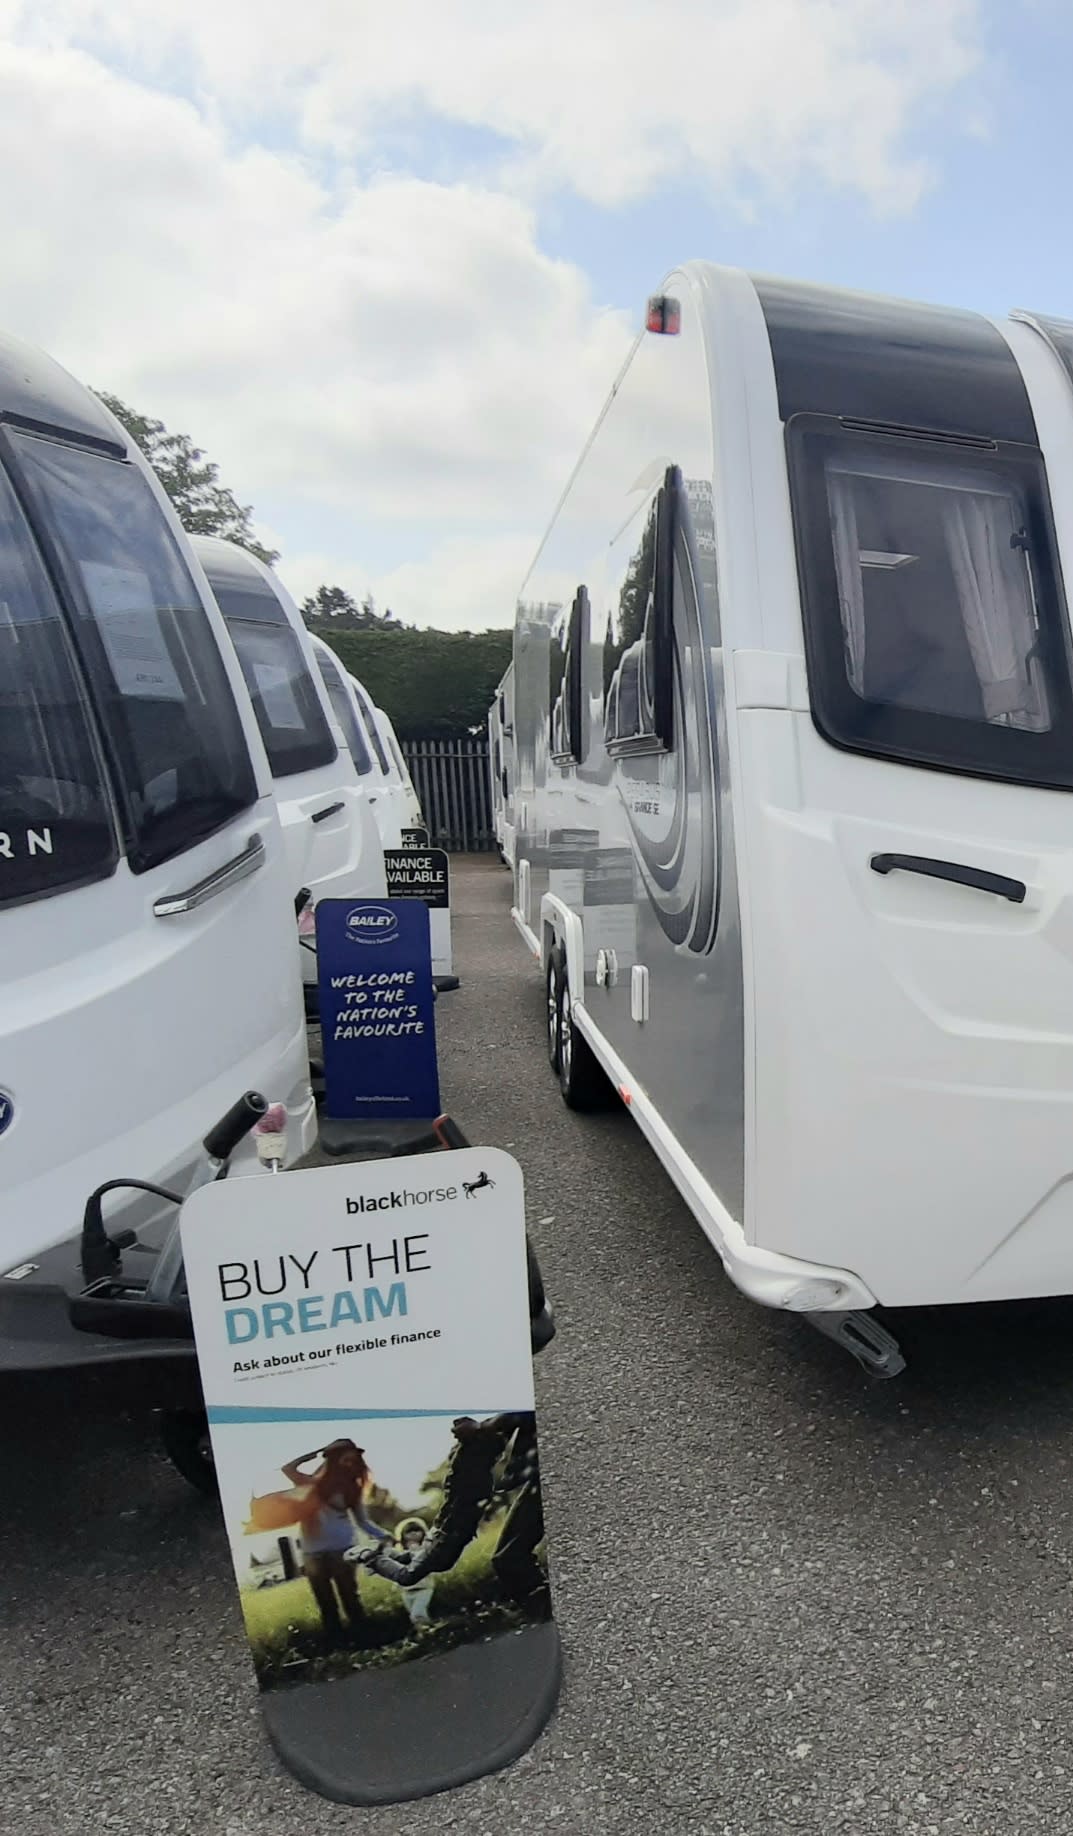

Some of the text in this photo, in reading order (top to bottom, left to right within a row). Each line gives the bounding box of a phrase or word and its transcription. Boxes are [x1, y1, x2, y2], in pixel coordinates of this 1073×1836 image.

[387, 871, 445, 883] VAILABLE
[349, 916, 394, 926] BAILEY
[330, 971, 415, 988] WELCOME
[344, 988, 406, 1005] TO THE
[336, 1005, 418, 1022] NATION'S
[334, 1021, 425, 1040] FAVOURITE
[346, 1186, 458, 1214] blackhorse
[218, 1233, 432, 1302] BUY THE
[224, 1281, 409, 1345] DREAM
[233, 1359, 260, 1373] Ask
[263, 1352, 306, 1368] about
[308, 1348, 333, 1360] our
[335, 1337, 387, 1355] flexible
[390, 1329, 441, 1345] finance
